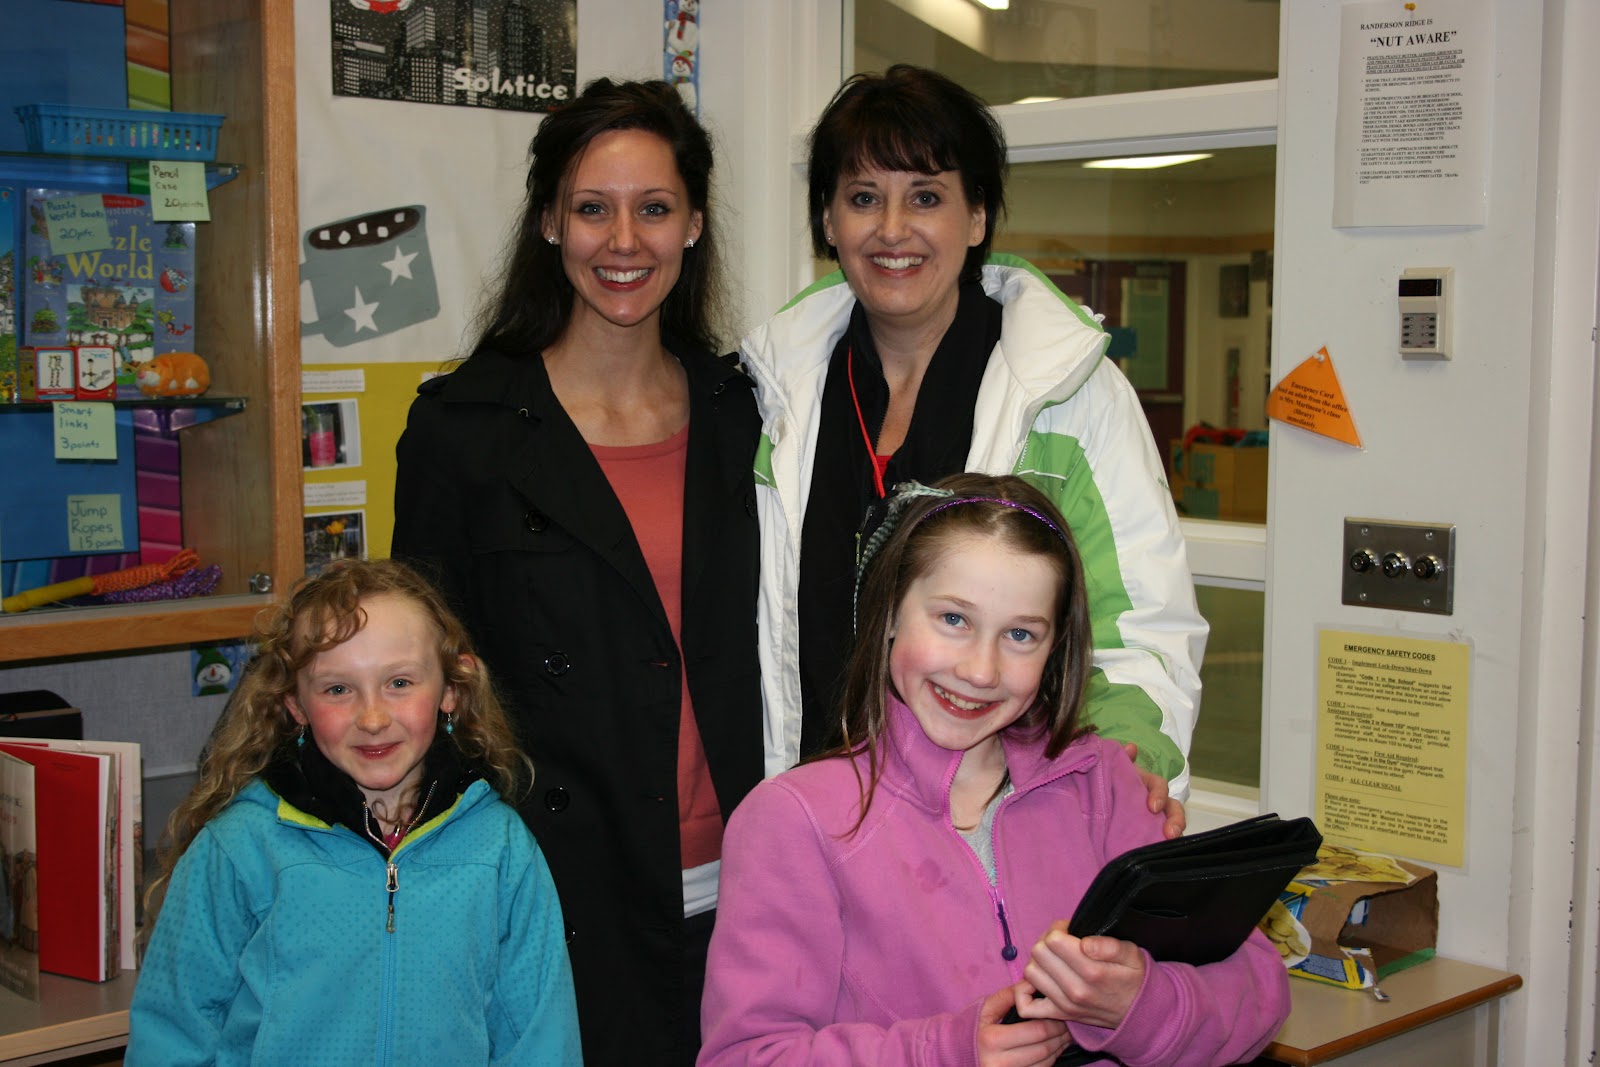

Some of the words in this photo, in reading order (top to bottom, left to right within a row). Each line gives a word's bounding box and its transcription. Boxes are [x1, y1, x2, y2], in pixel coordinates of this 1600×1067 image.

[1360, 22, 1403, 30] RANDERSON
[454, 66, 568, 100] Solstice
[152, 165, 179, 178] Pencil
[66, 252, 154, 280] World
[1291, 382, 1318, 395] Emergency
[1320, 390, 1335, 399] Card
[58, 404, 93, 416] Smart
[1308, 396, 1321, 404] from
[1332, 403, 1348, 412] office
[1327, 410, 1341, 419] class
[59, 417, 89, 430] links
[71, 500, 108, 518] Jump
[71, 518, 114, 538] Ropes
[1344, 644, 1384, 655] EMERGENCY
[1386, 649, 1411, 658] SAFETY
[1412, 652, 1436, 661] CODES
[1352, 660, 1377, 670] Implement
[1353, 766, 1370, 774] Training
[1325, 774, 1340, 782] CODE
[1362, 780, 1380, 788] CLEAR
[1381, 783, 1402, 792] SIGNAL
